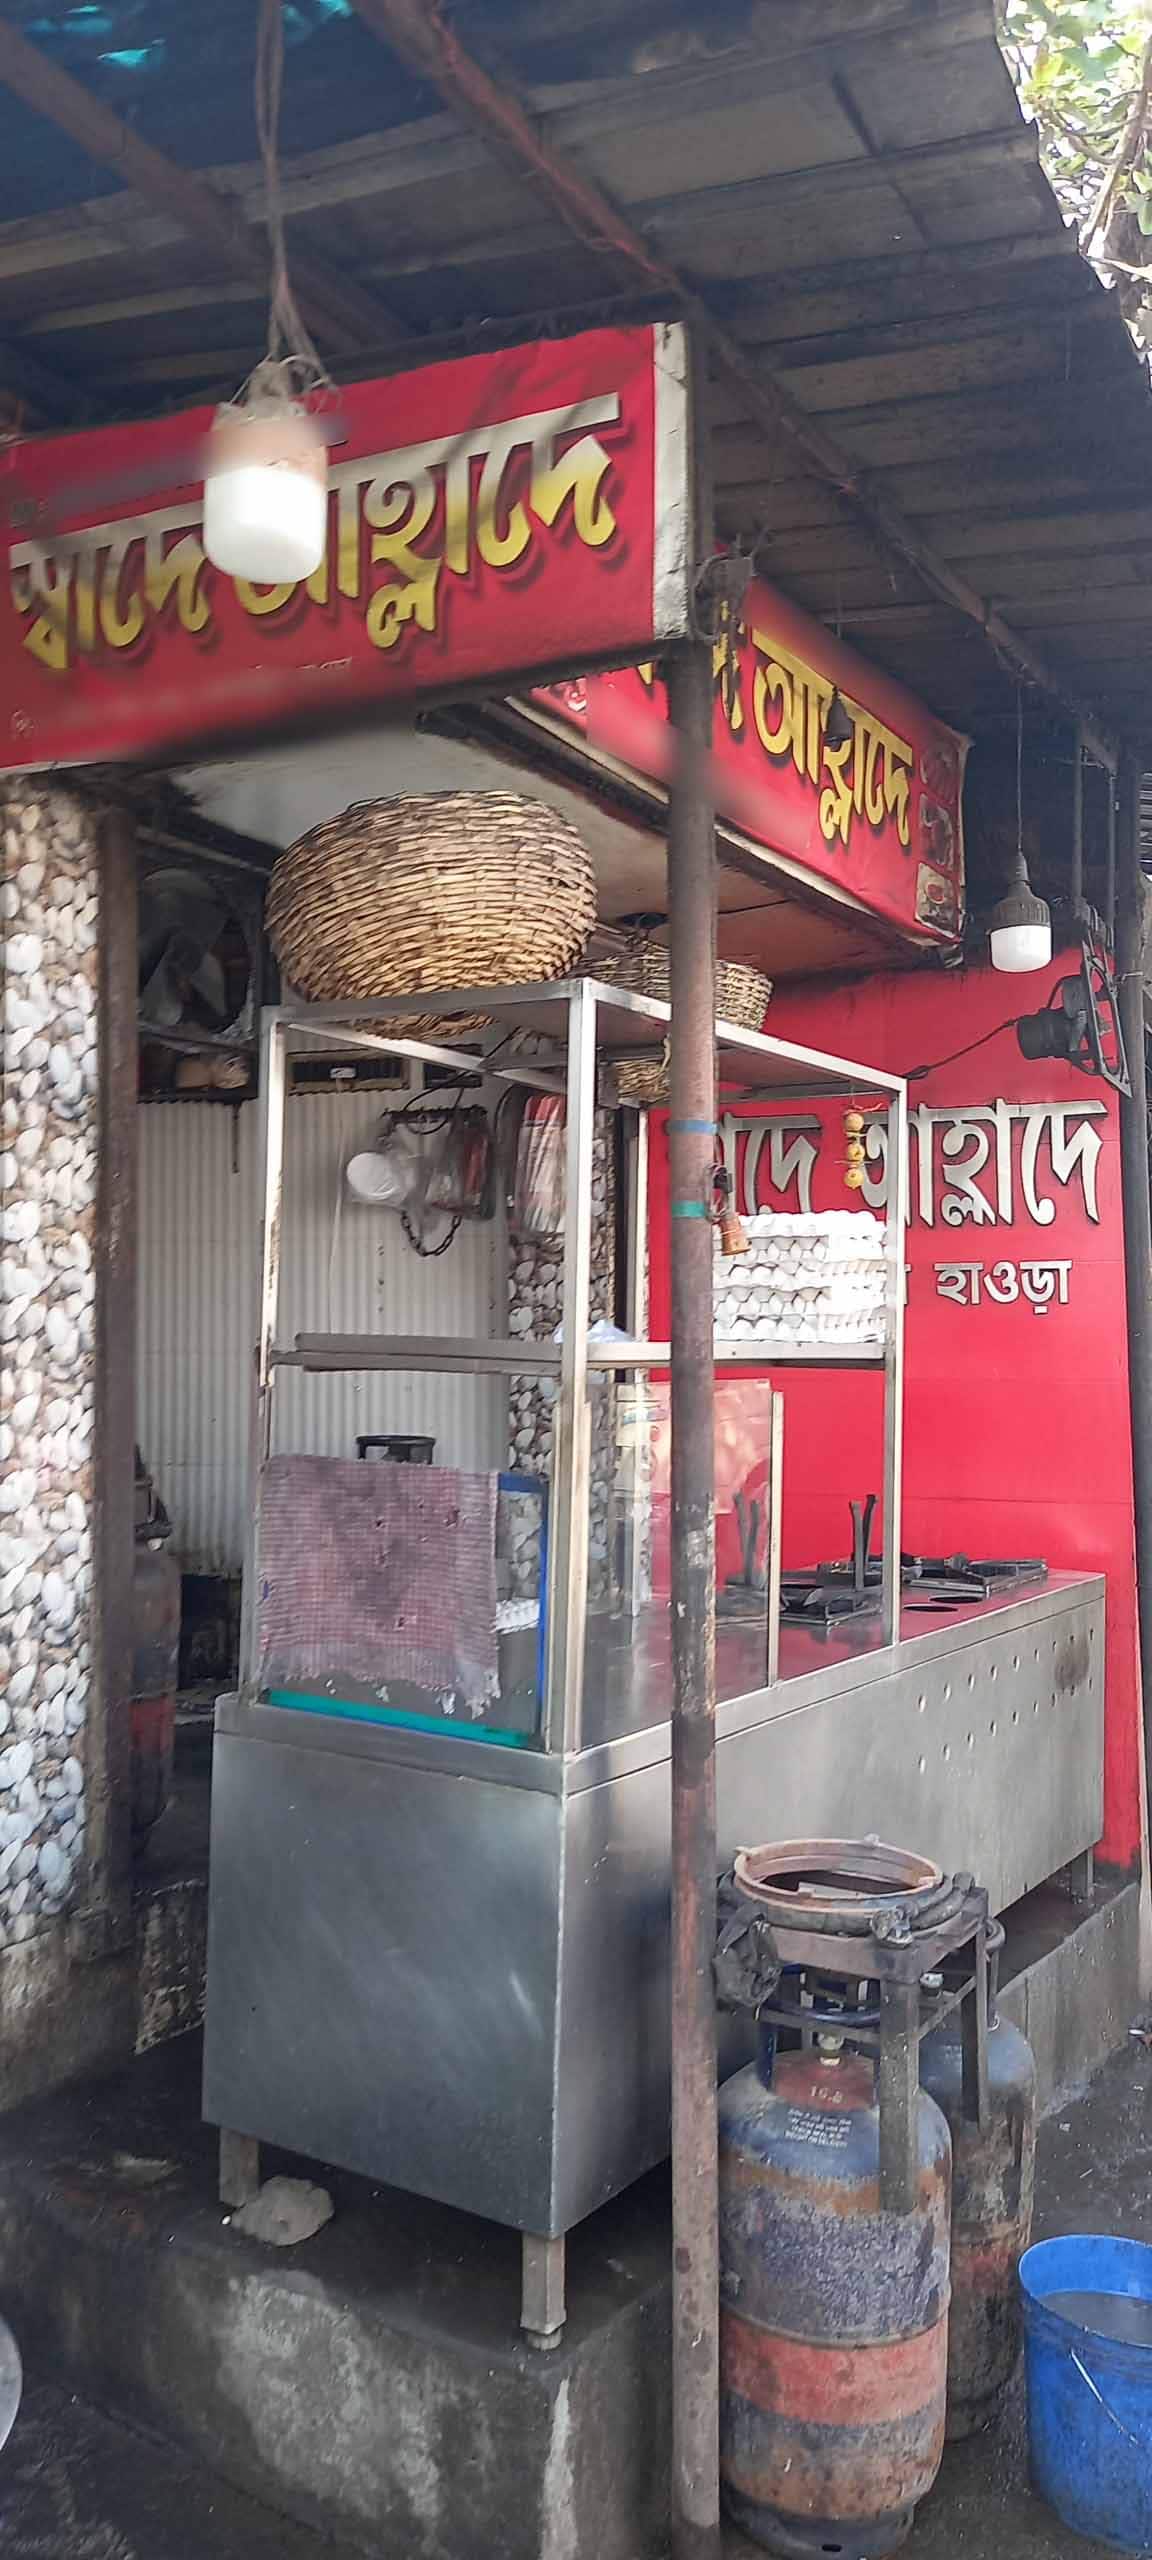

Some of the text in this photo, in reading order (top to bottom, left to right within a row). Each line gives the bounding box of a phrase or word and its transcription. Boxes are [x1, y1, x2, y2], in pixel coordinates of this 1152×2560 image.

[10, 498, 209, 670] স্বাদে
[860, 1097, 1108, 1227] আহ্লাদে
[934, 1259, 1073, 1315] হাওড়া
